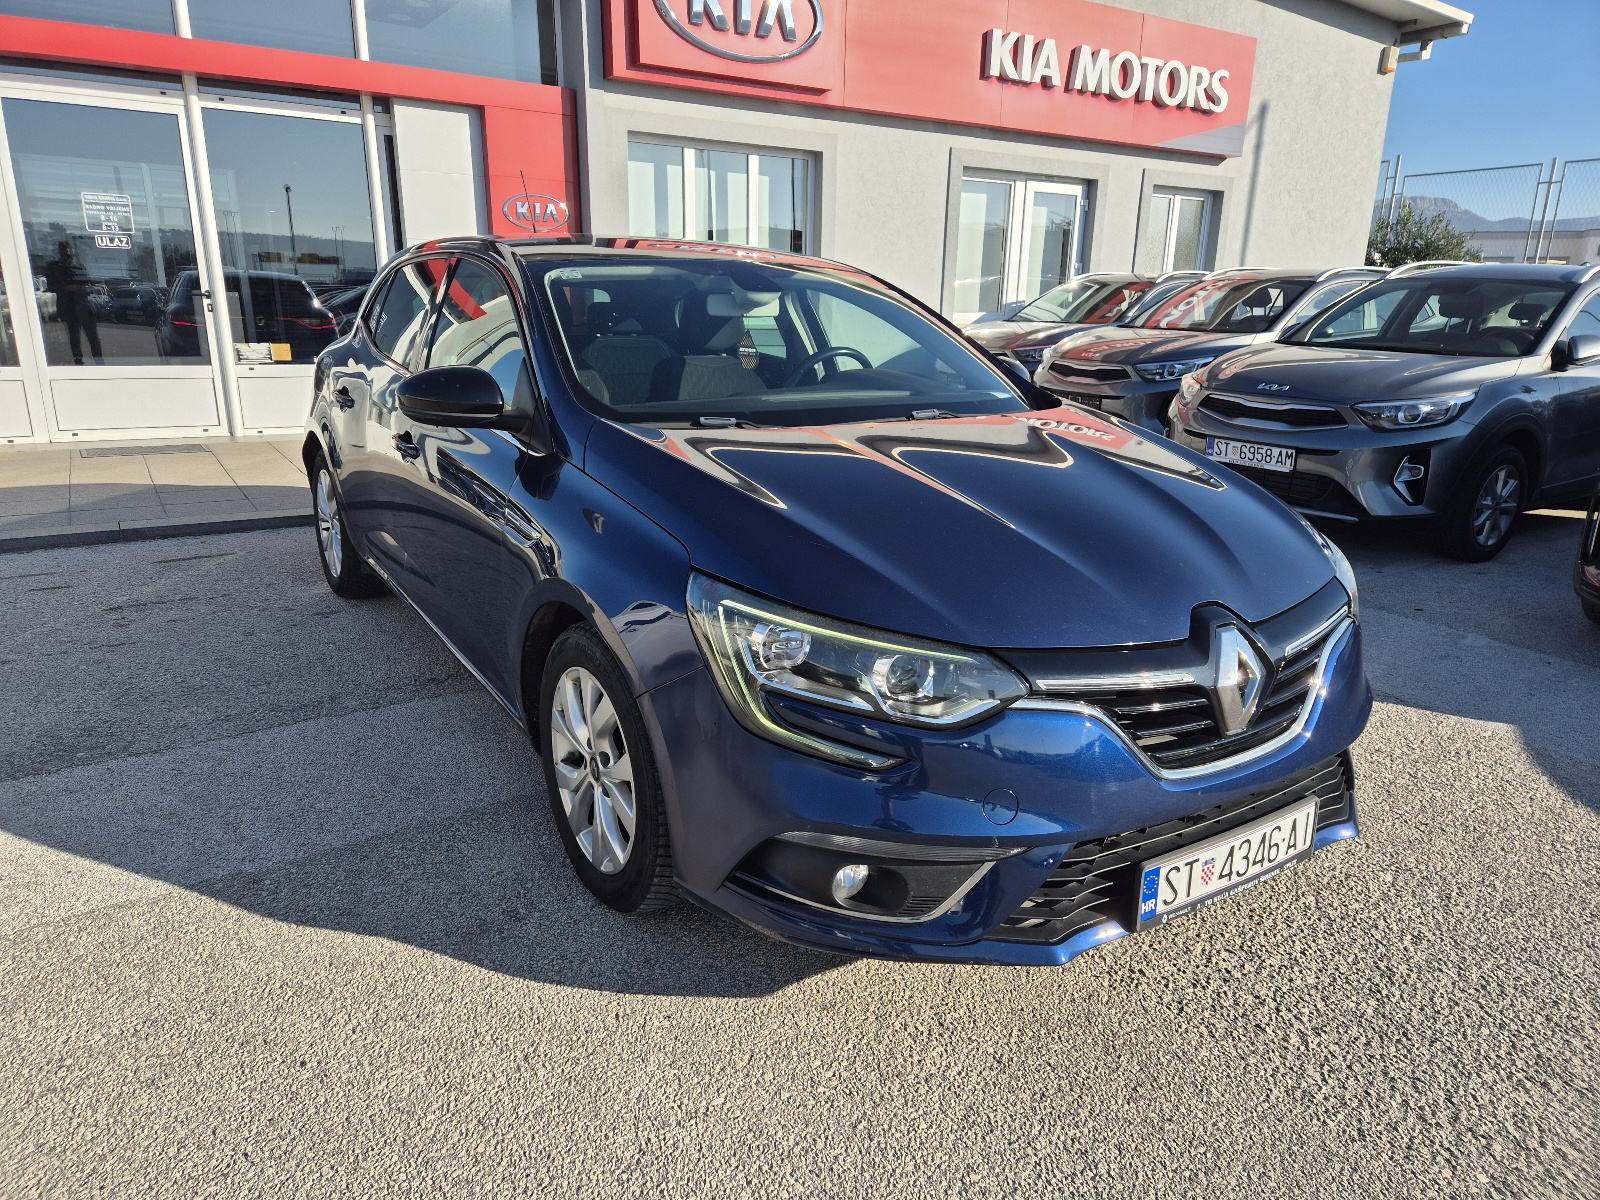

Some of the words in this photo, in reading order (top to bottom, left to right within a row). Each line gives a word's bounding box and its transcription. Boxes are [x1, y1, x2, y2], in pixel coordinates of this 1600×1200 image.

[983, 28, 1061, 88] KIA
[1070, 44, 1229, 114] MOTORS
[515, 201, 559, 222] KIA
[97, 236, 129, 247] ULAZ
[1215, 440, 1231, 457] ST
[1163, 858, 1200, 906] ST
[1168, 906, 1191, 919] RENAULT
[1283, 859, 1298, 871] SPLIT
[1141, 899, 1156, 915] HR
